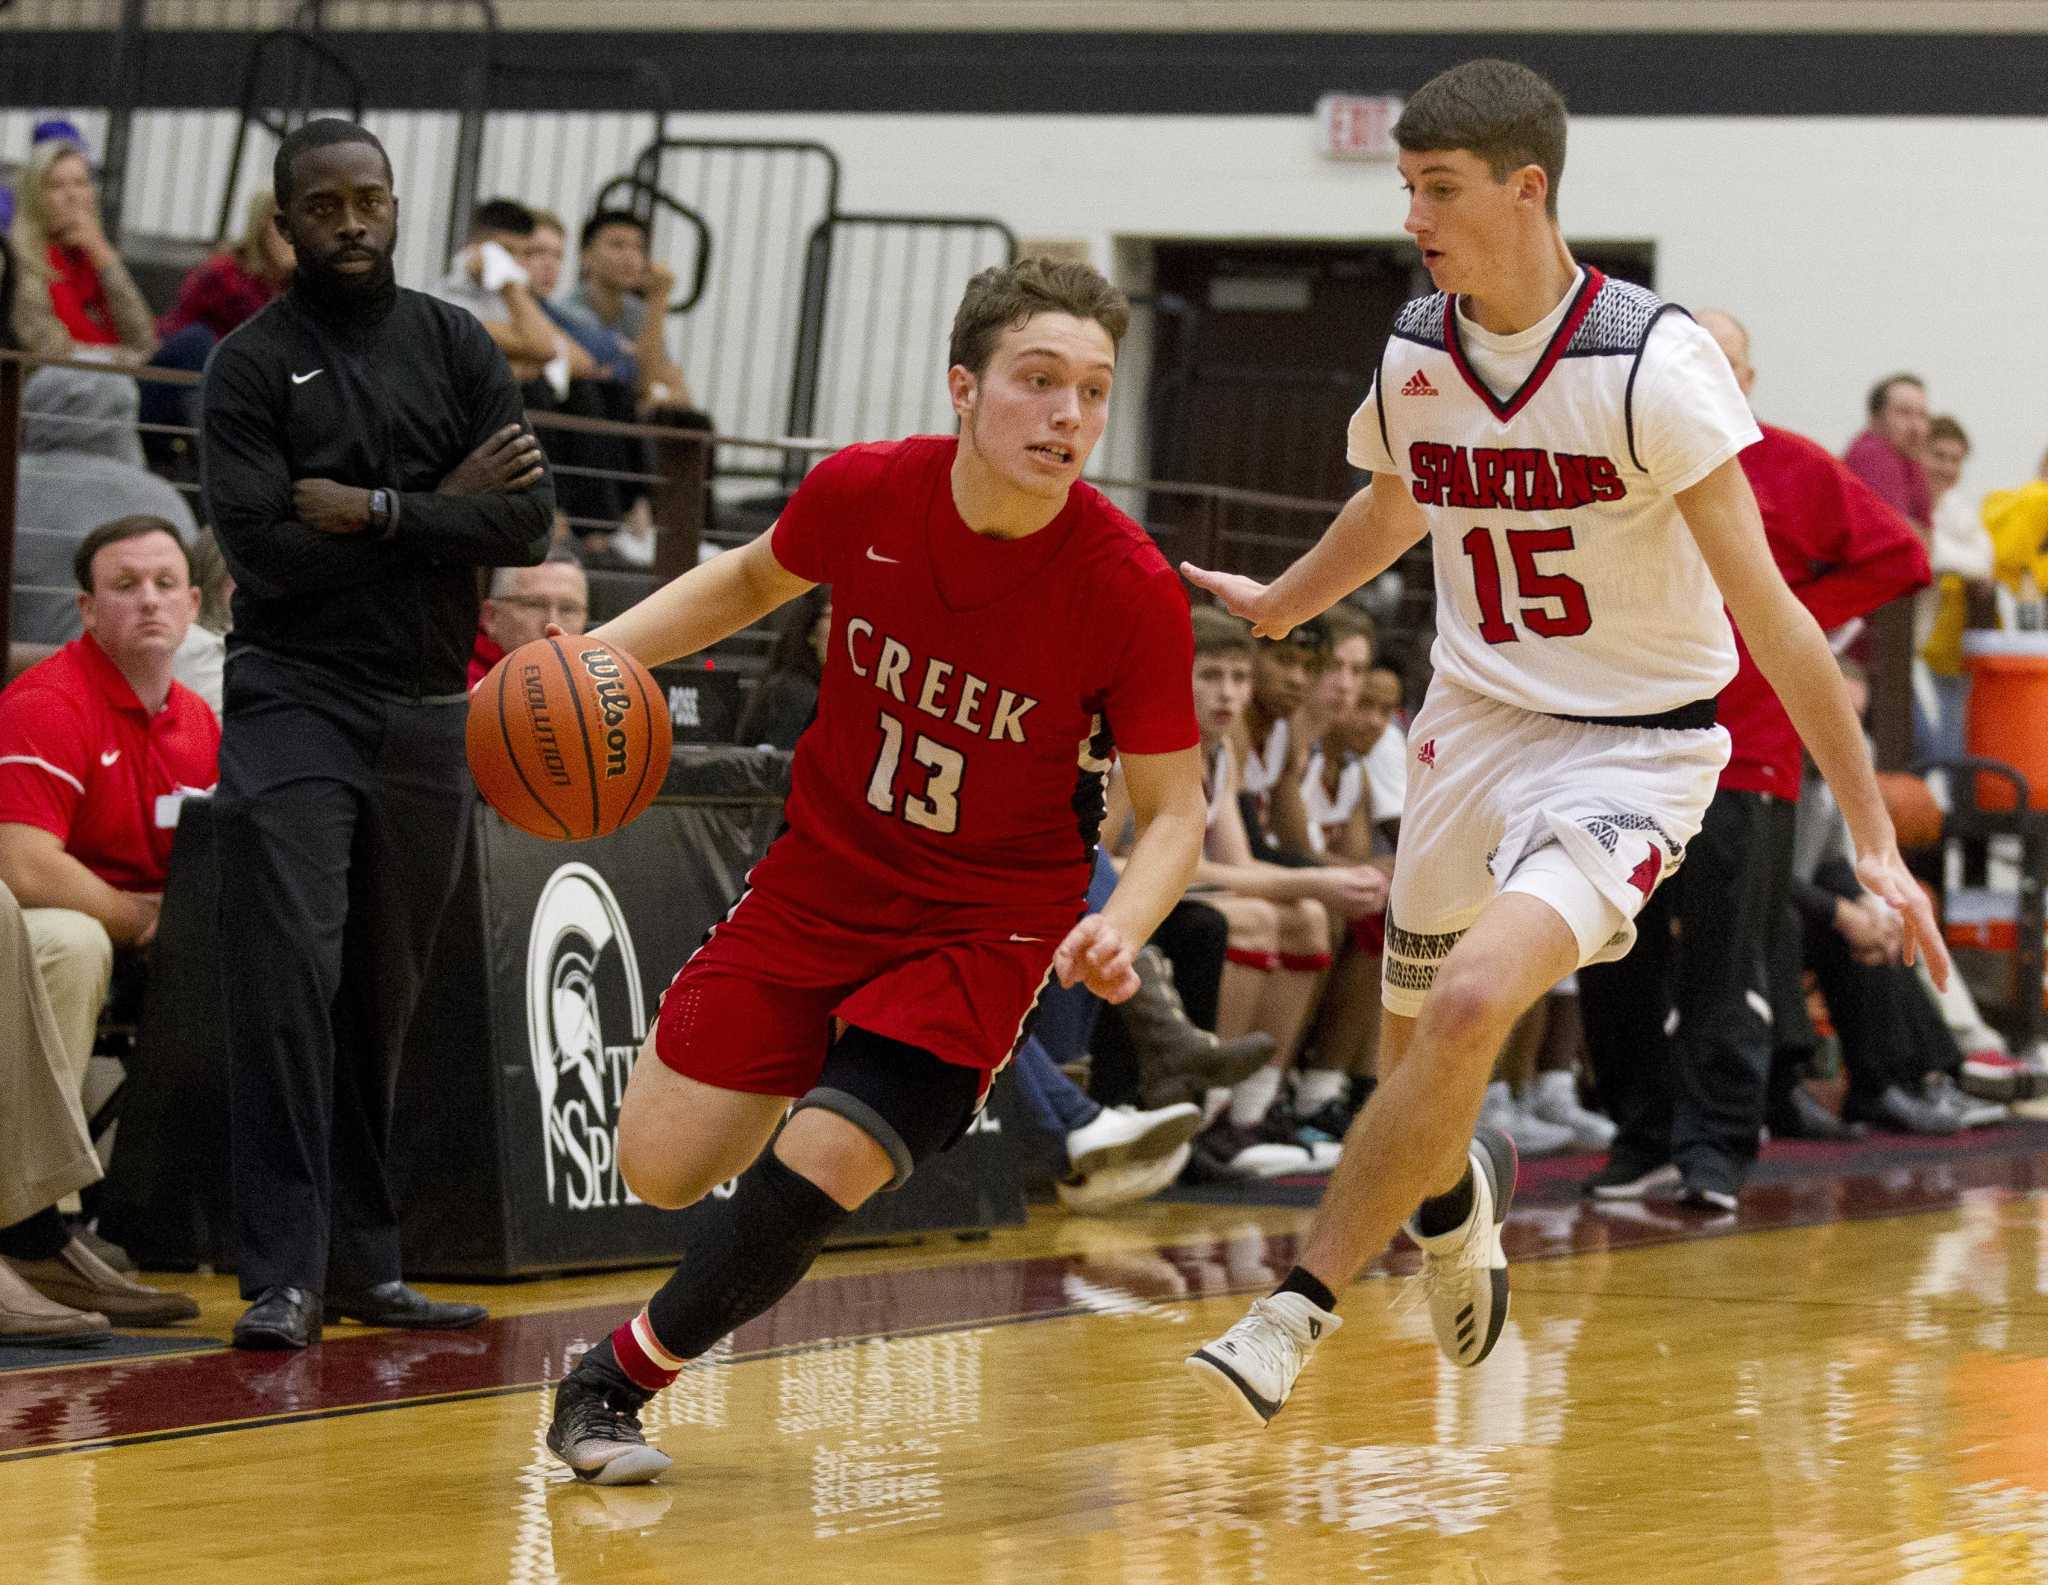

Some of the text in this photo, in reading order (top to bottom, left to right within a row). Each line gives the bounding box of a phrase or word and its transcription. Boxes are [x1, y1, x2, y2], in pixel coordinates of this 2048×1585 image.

[1409, 441, 1627, 511] SPARTANS
[1462, 526, 1593, 644] 15
[579, 648, 631, 779] Wilson
[847, 618, 1039, 743] CREEK
[866, 712, 966, 834] 13
